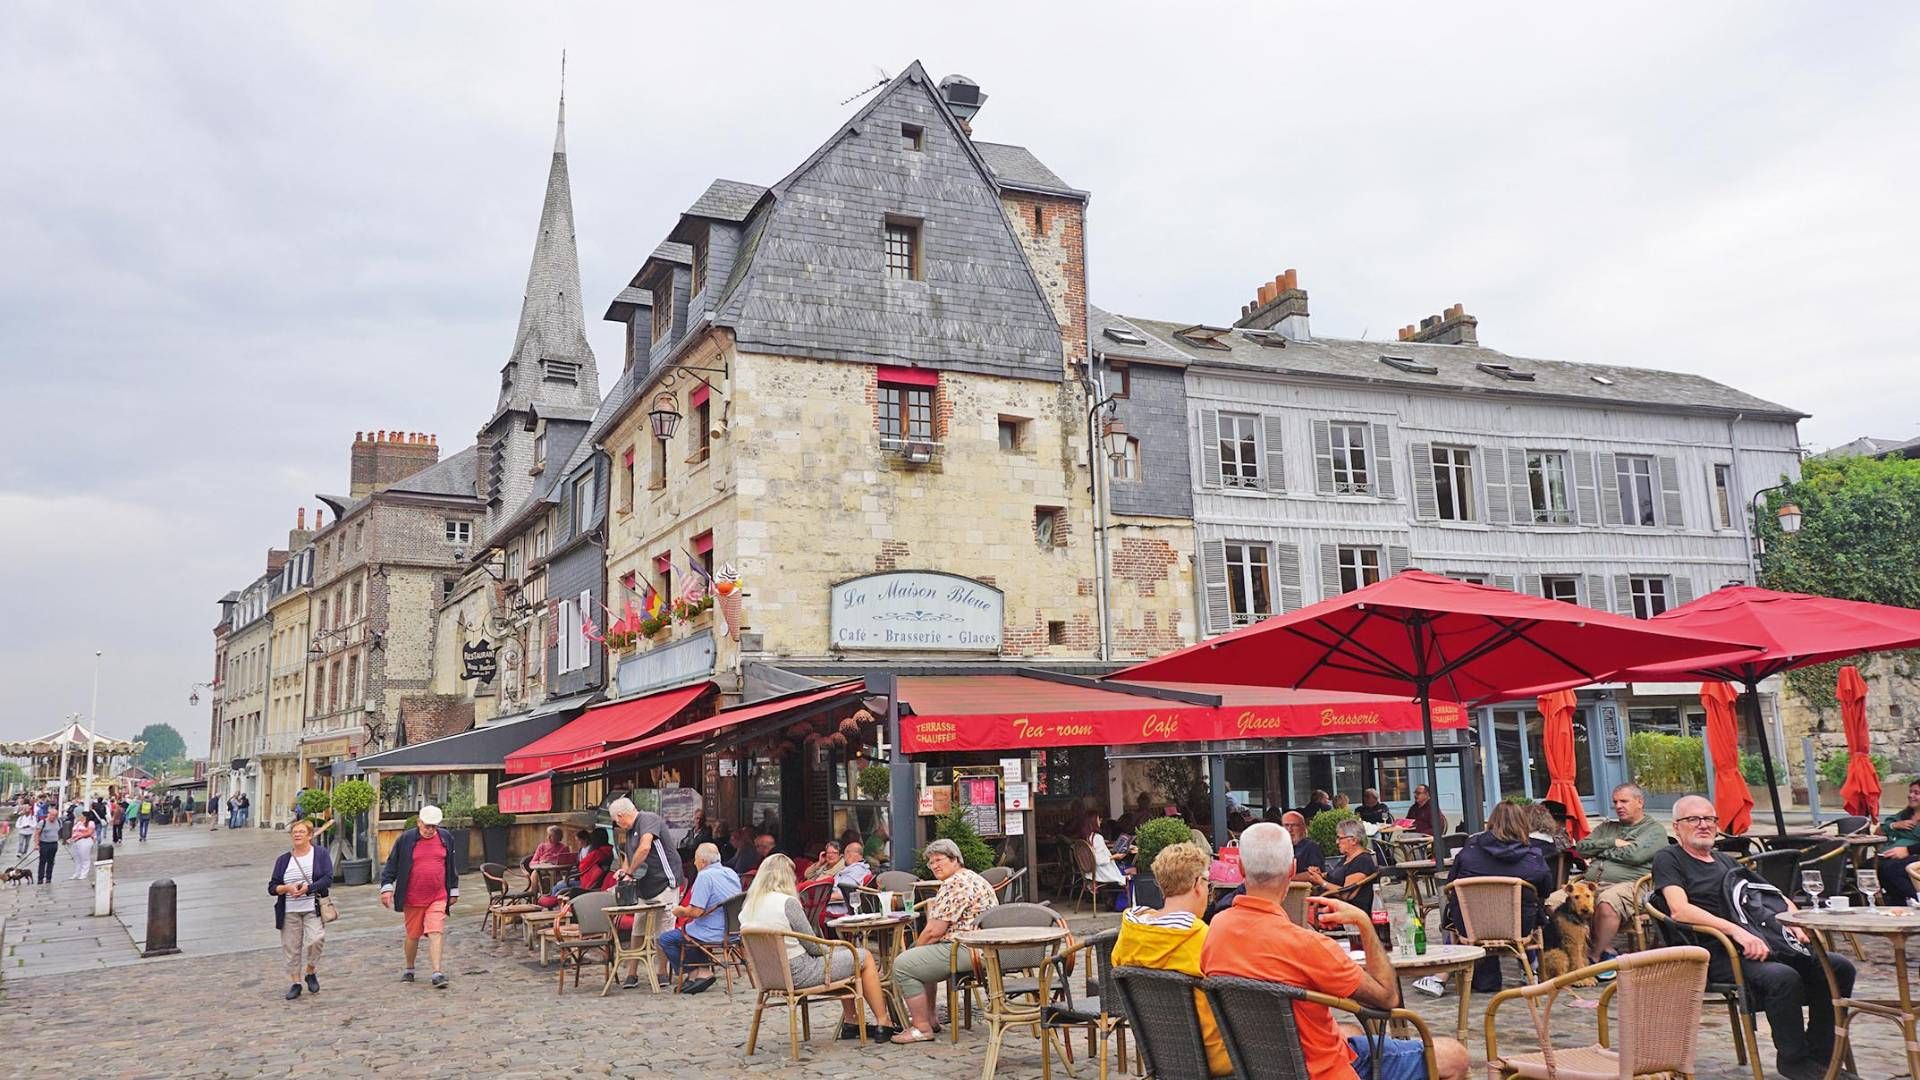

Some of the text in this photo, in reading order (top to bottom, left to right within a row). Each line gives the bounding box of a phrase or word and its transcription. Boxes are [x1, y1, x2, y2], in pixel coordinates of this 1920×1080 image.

[843, 580, 992, 611] La Maison Bleue
[886, 629, 941, 643] Brasserie
[959, 631, 996, 644] Glaces
[916, 721, 957, 732] TERRASSE
[1142, 713, 1178, 738] Café
[1237, 712, 1281, 735] Glaces
[1320, 708, 1379, 726] Brasserie
